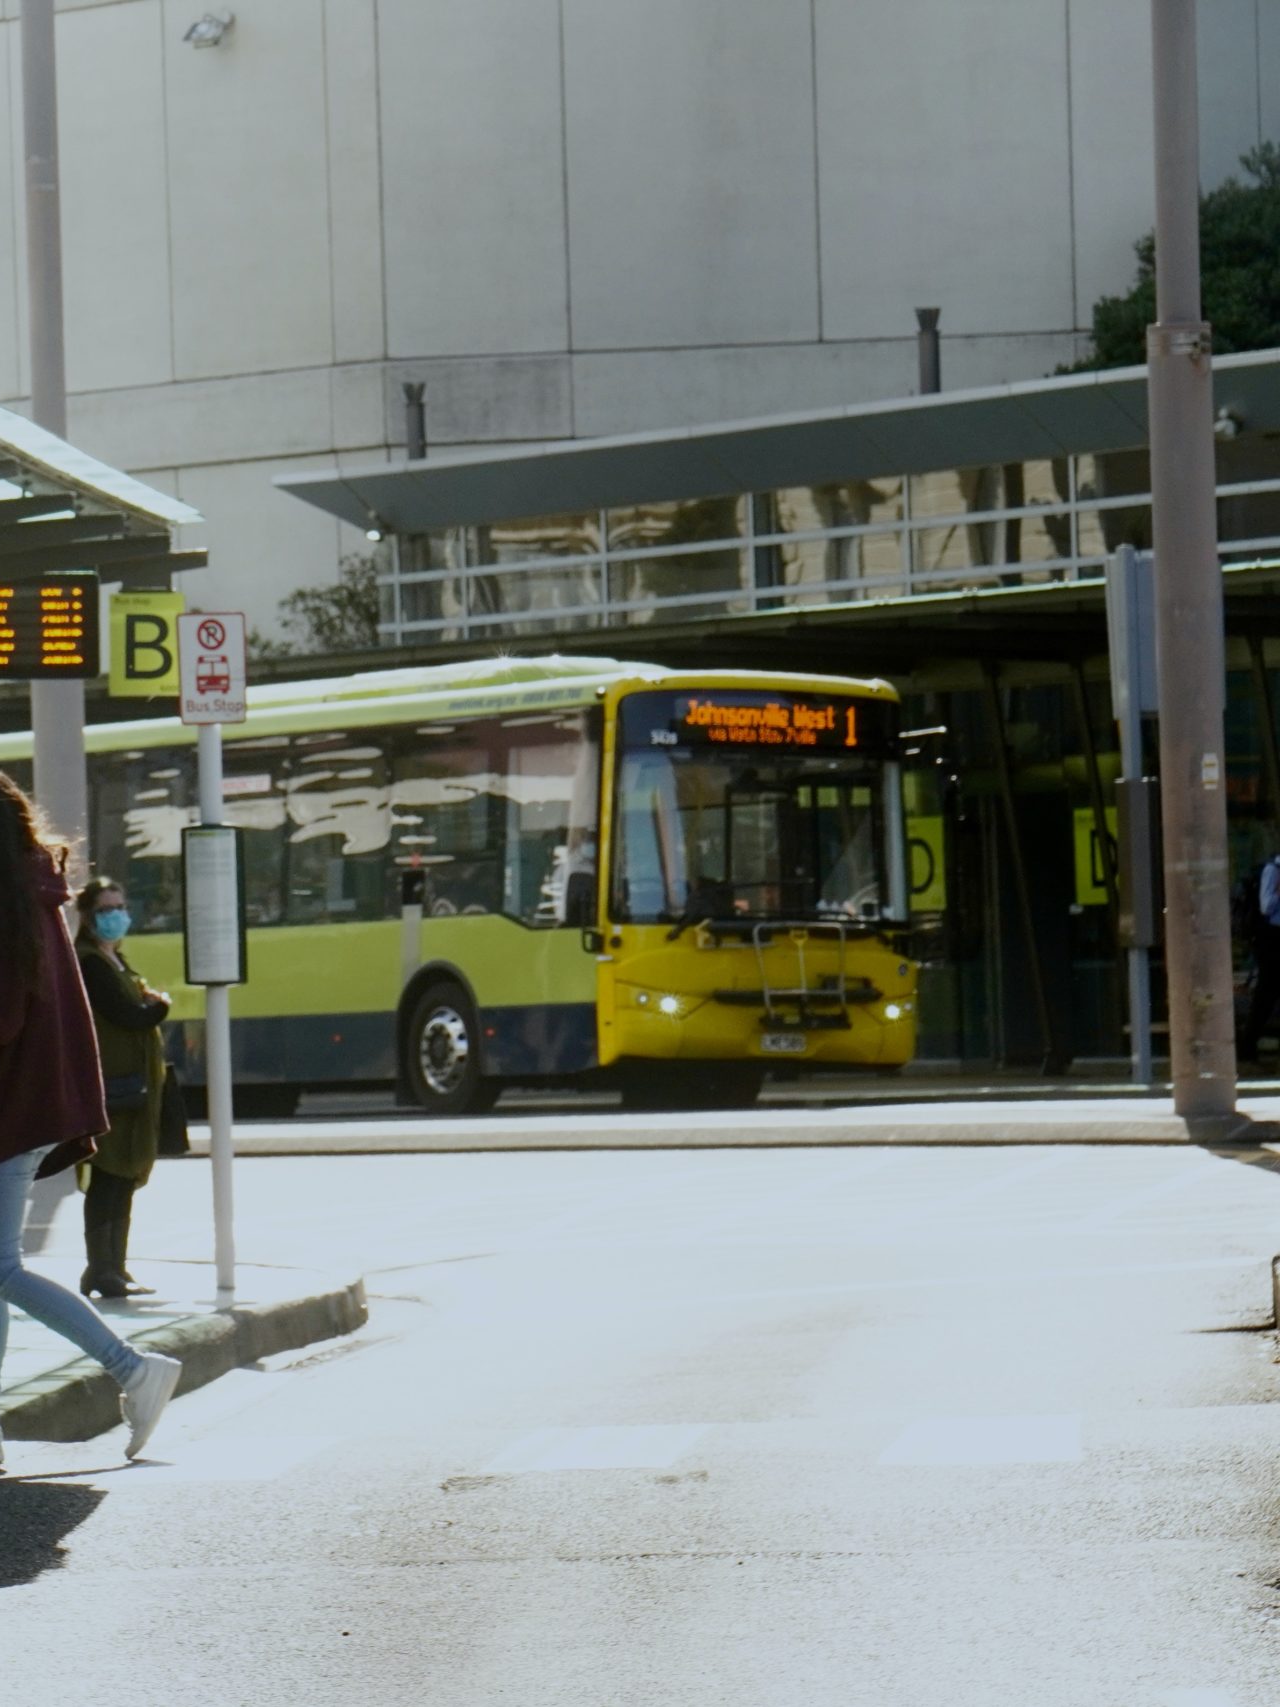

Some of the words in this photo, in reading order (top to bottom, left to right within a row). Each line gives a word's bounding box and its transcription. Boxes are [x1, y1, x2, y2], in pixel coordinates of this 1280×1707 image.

[125, 613, 173, 679] B
[186, 700, 211, 713] Bus
[213, 699, 245, 714] Stop
[685, 699, 789, 729] Johnsonville
[793, 704, 835, 730] West
[845, 705, 857, 747] 1
